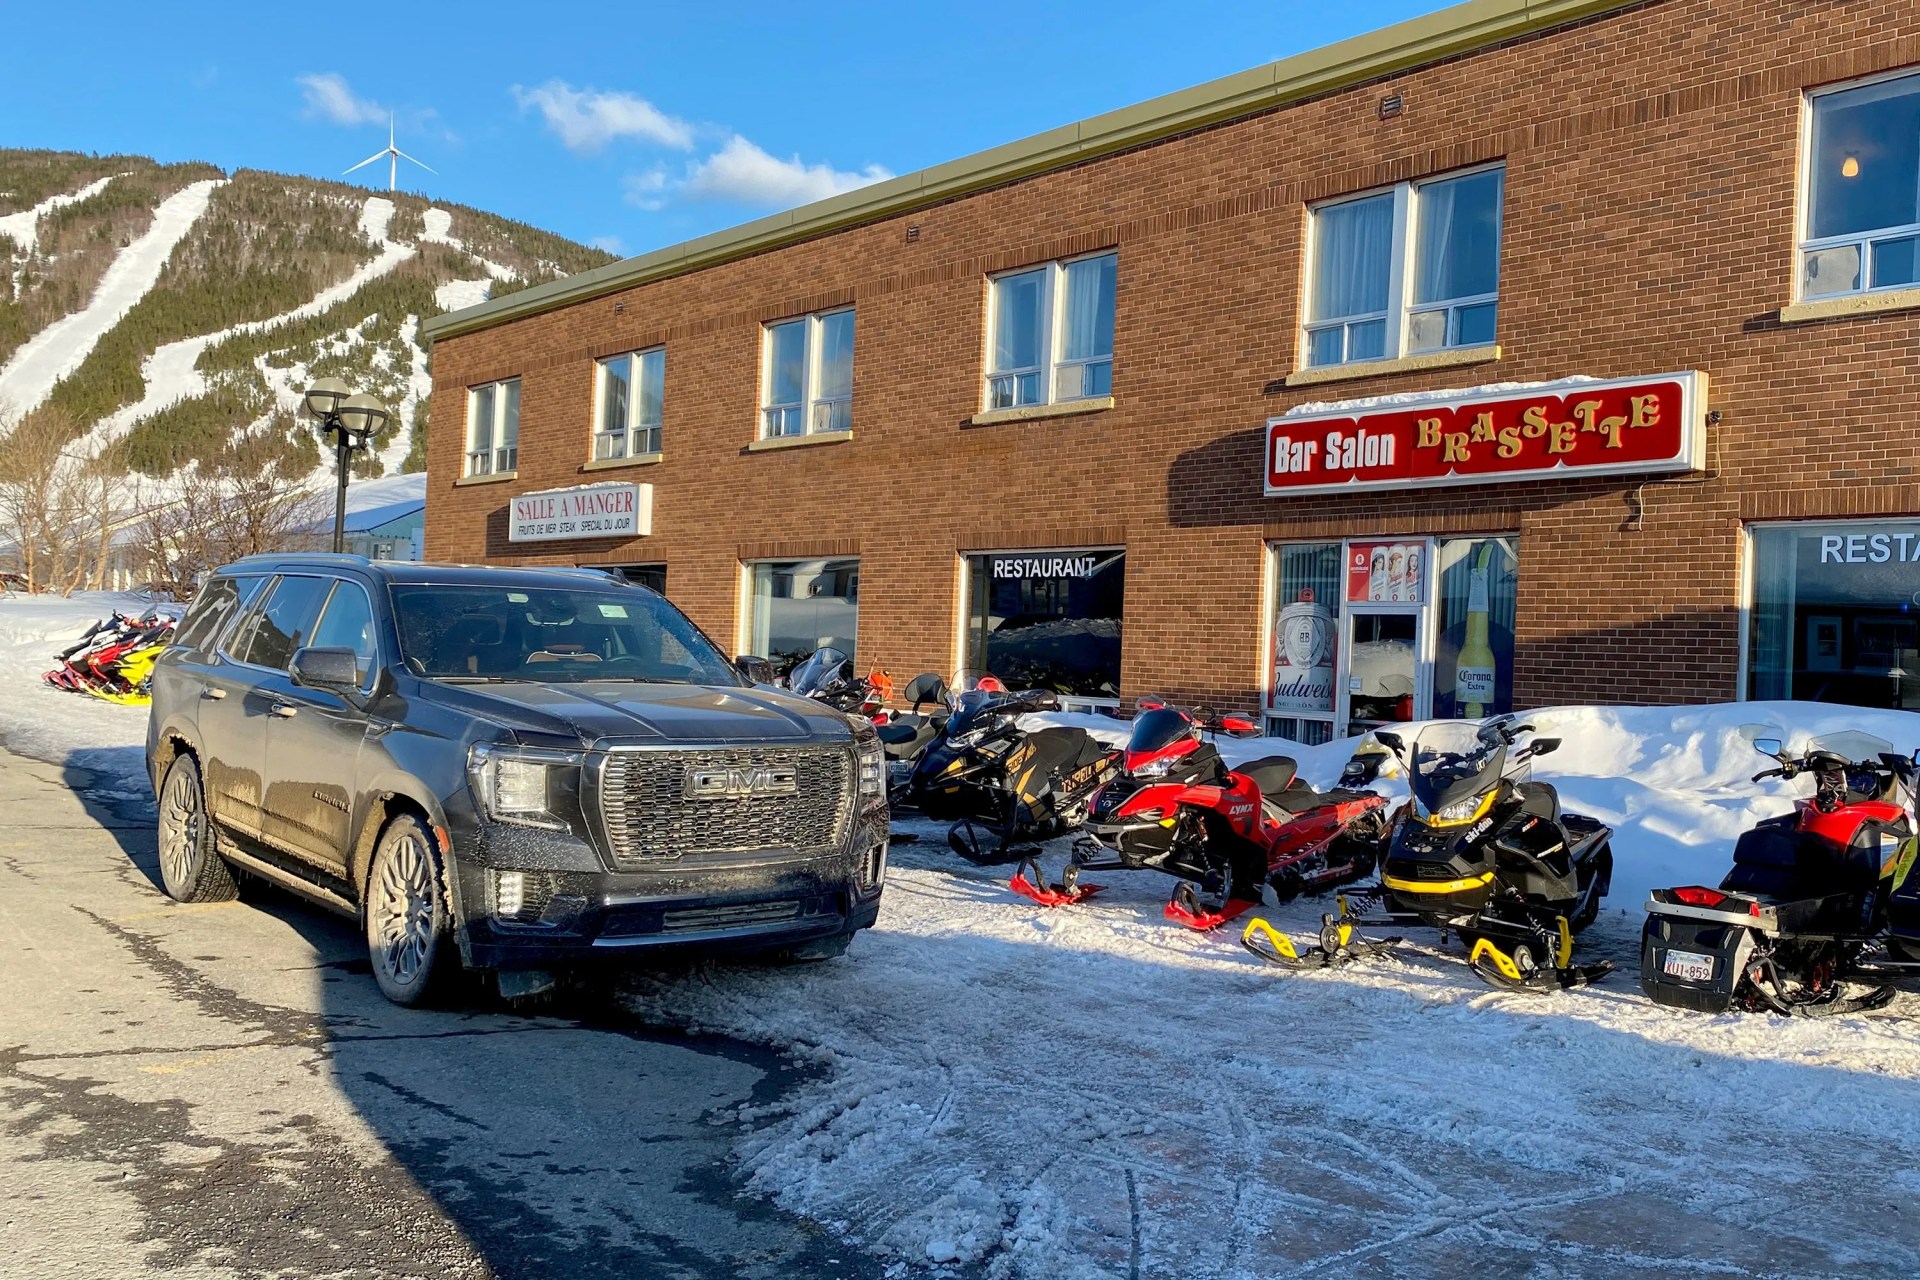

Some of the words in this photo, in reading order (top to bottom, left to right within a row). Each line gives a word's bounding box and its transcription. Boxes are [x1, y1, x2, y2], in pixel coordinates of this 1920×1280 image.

[1274, 435, 1317, 474] Bar
[1325, 429, 1396, 470] Salon
[1417, 394, 1662, 463] BRASSETTE
[517, 498, 555, 521] SALLE
[560, 497, 569, 518] A
[574, 491, 633, 516] MANGER
[518, 524, 535, 536] FRUITS
[536, 524, 545, 535] DE
[545, 523, 557, 534] MER
[559, 522, 577, 533] STEAK
[581, 520, 603, 532] SPECIAL
[604, 519, 613, 530] DU
[614, 518, 630, 529] JOUR
[993, 557, 1096, 578] RESTAURANT
[1458, 670, 1494, 683] Corona
[694, 767, 797, 794] GMC
[1464, 817, 1494, 844] ski-doo
